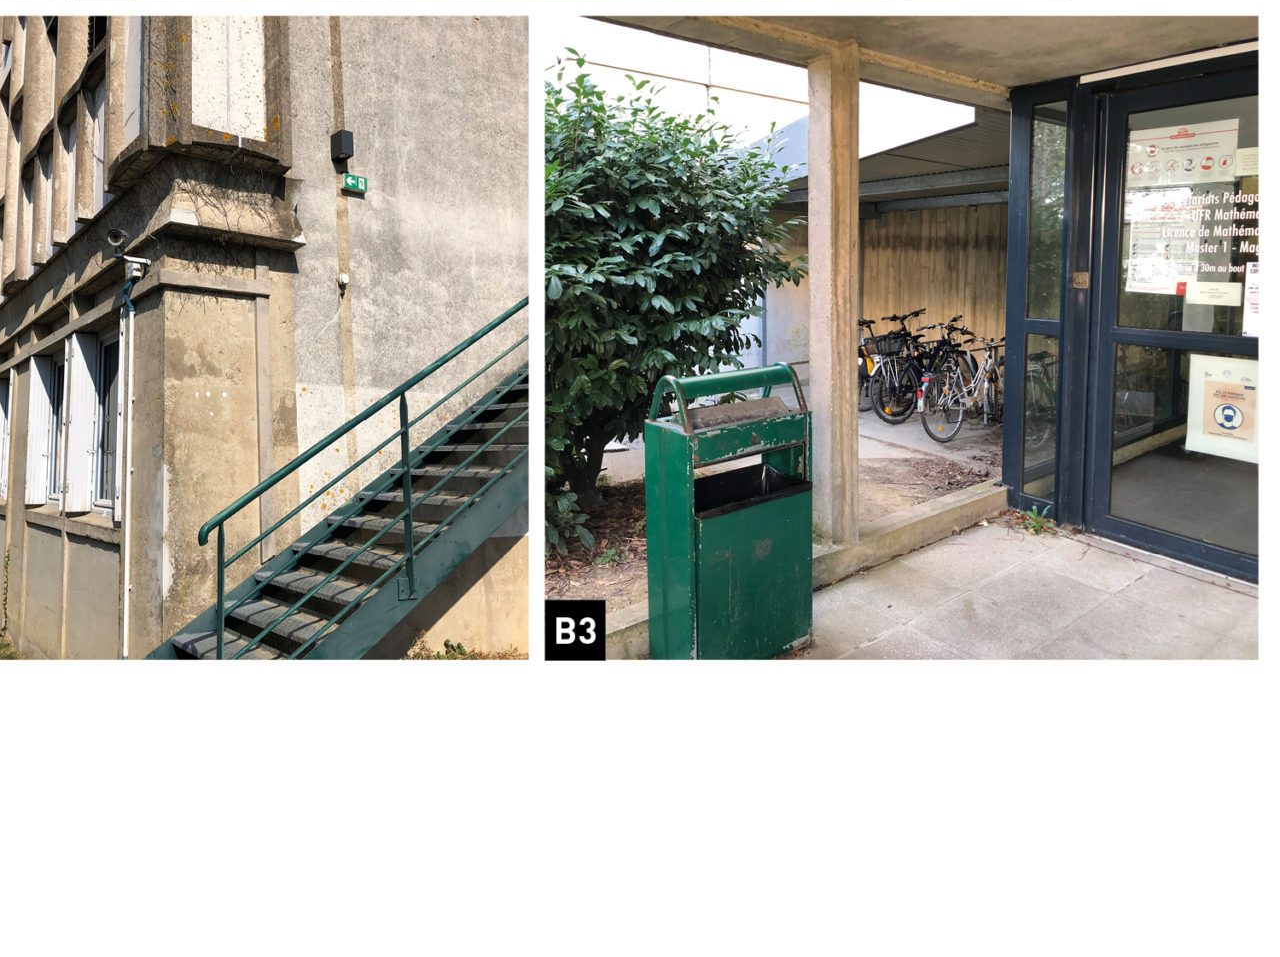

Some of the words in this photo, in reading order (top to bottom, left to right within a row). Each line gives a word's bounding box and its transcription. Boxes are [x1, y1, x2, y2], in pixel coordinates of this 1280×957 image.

[1199, 223, 1210, 237] de
[1185, 240, 1218, 254] Master
[1223, 241, 1227, 253] 1
[1200, 263, 1216, 273] 30m
[1217, 265, 1227, 273] au
[1228, 262, 1245, 273] bout
